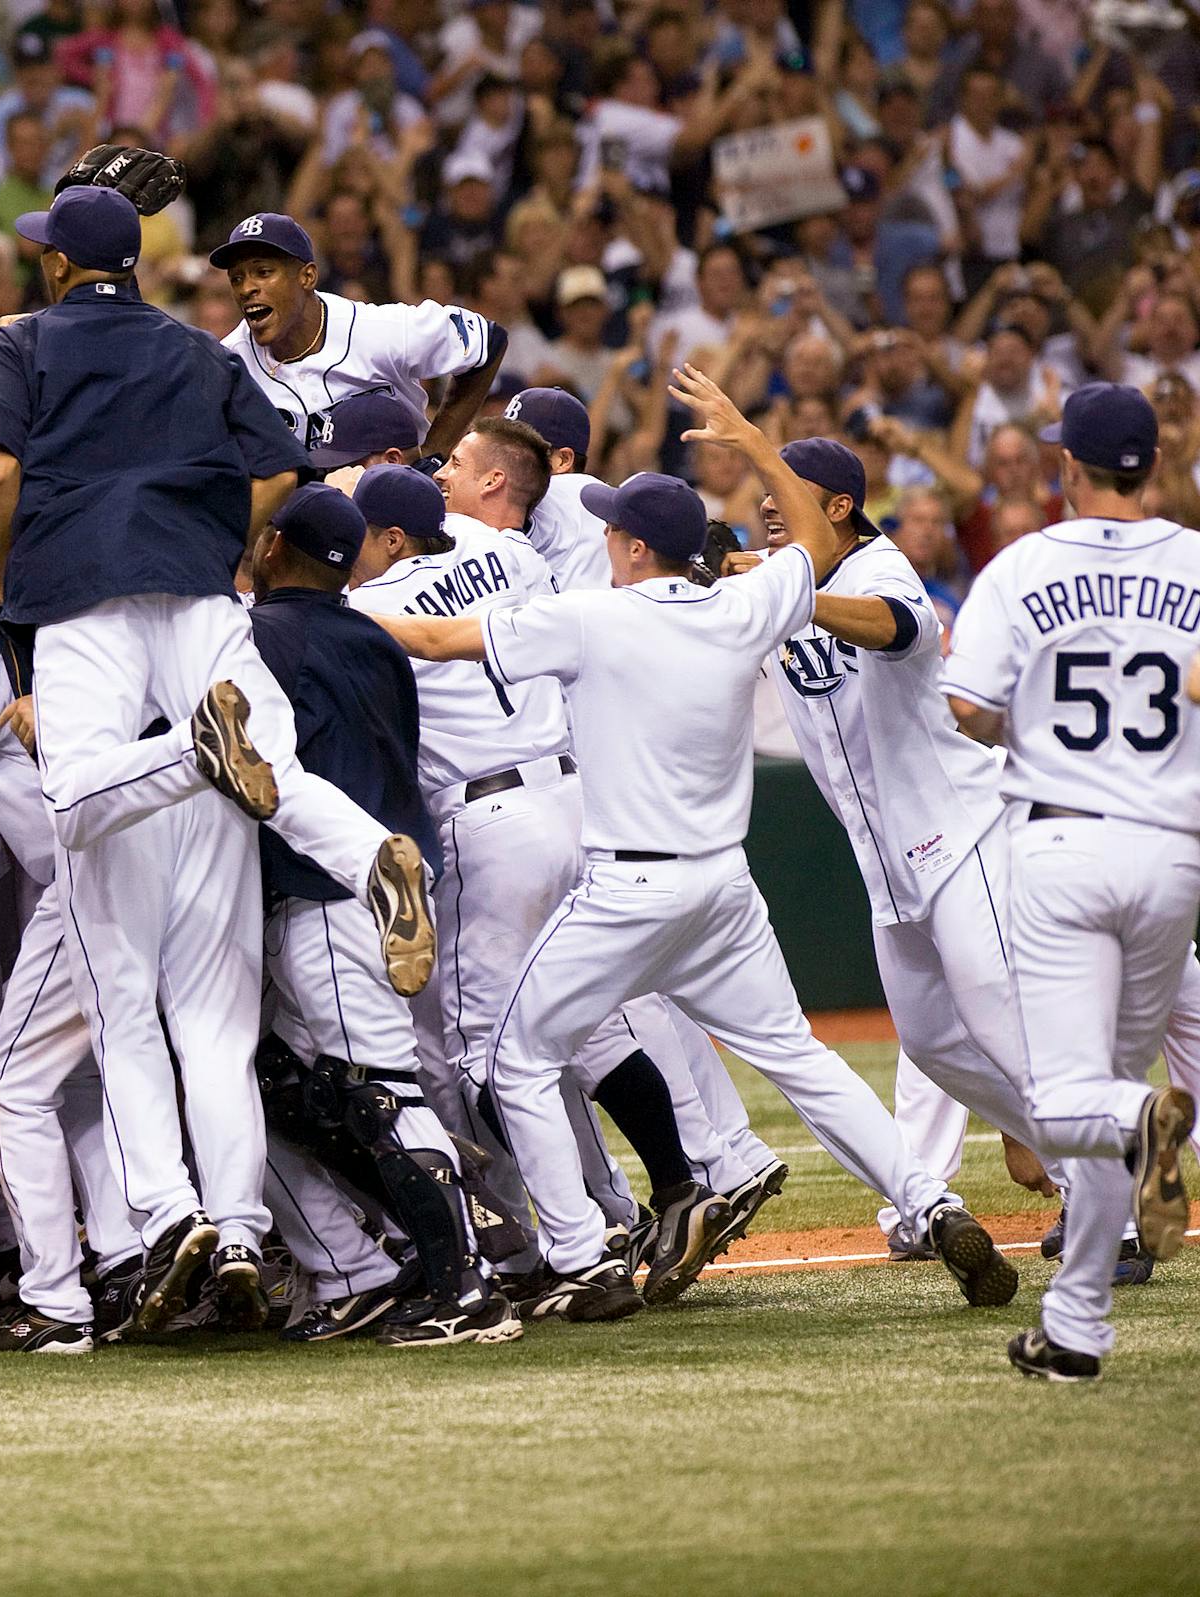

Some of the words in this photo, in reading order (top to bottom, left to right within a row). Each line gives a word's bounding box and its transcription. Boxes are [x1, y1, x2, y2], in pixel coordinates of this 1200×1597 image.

[104, 154, 133, 178] TPX
[1022, 573, 1200, 635] BRADFORD
[1053, 651, 1180, 752] 53
